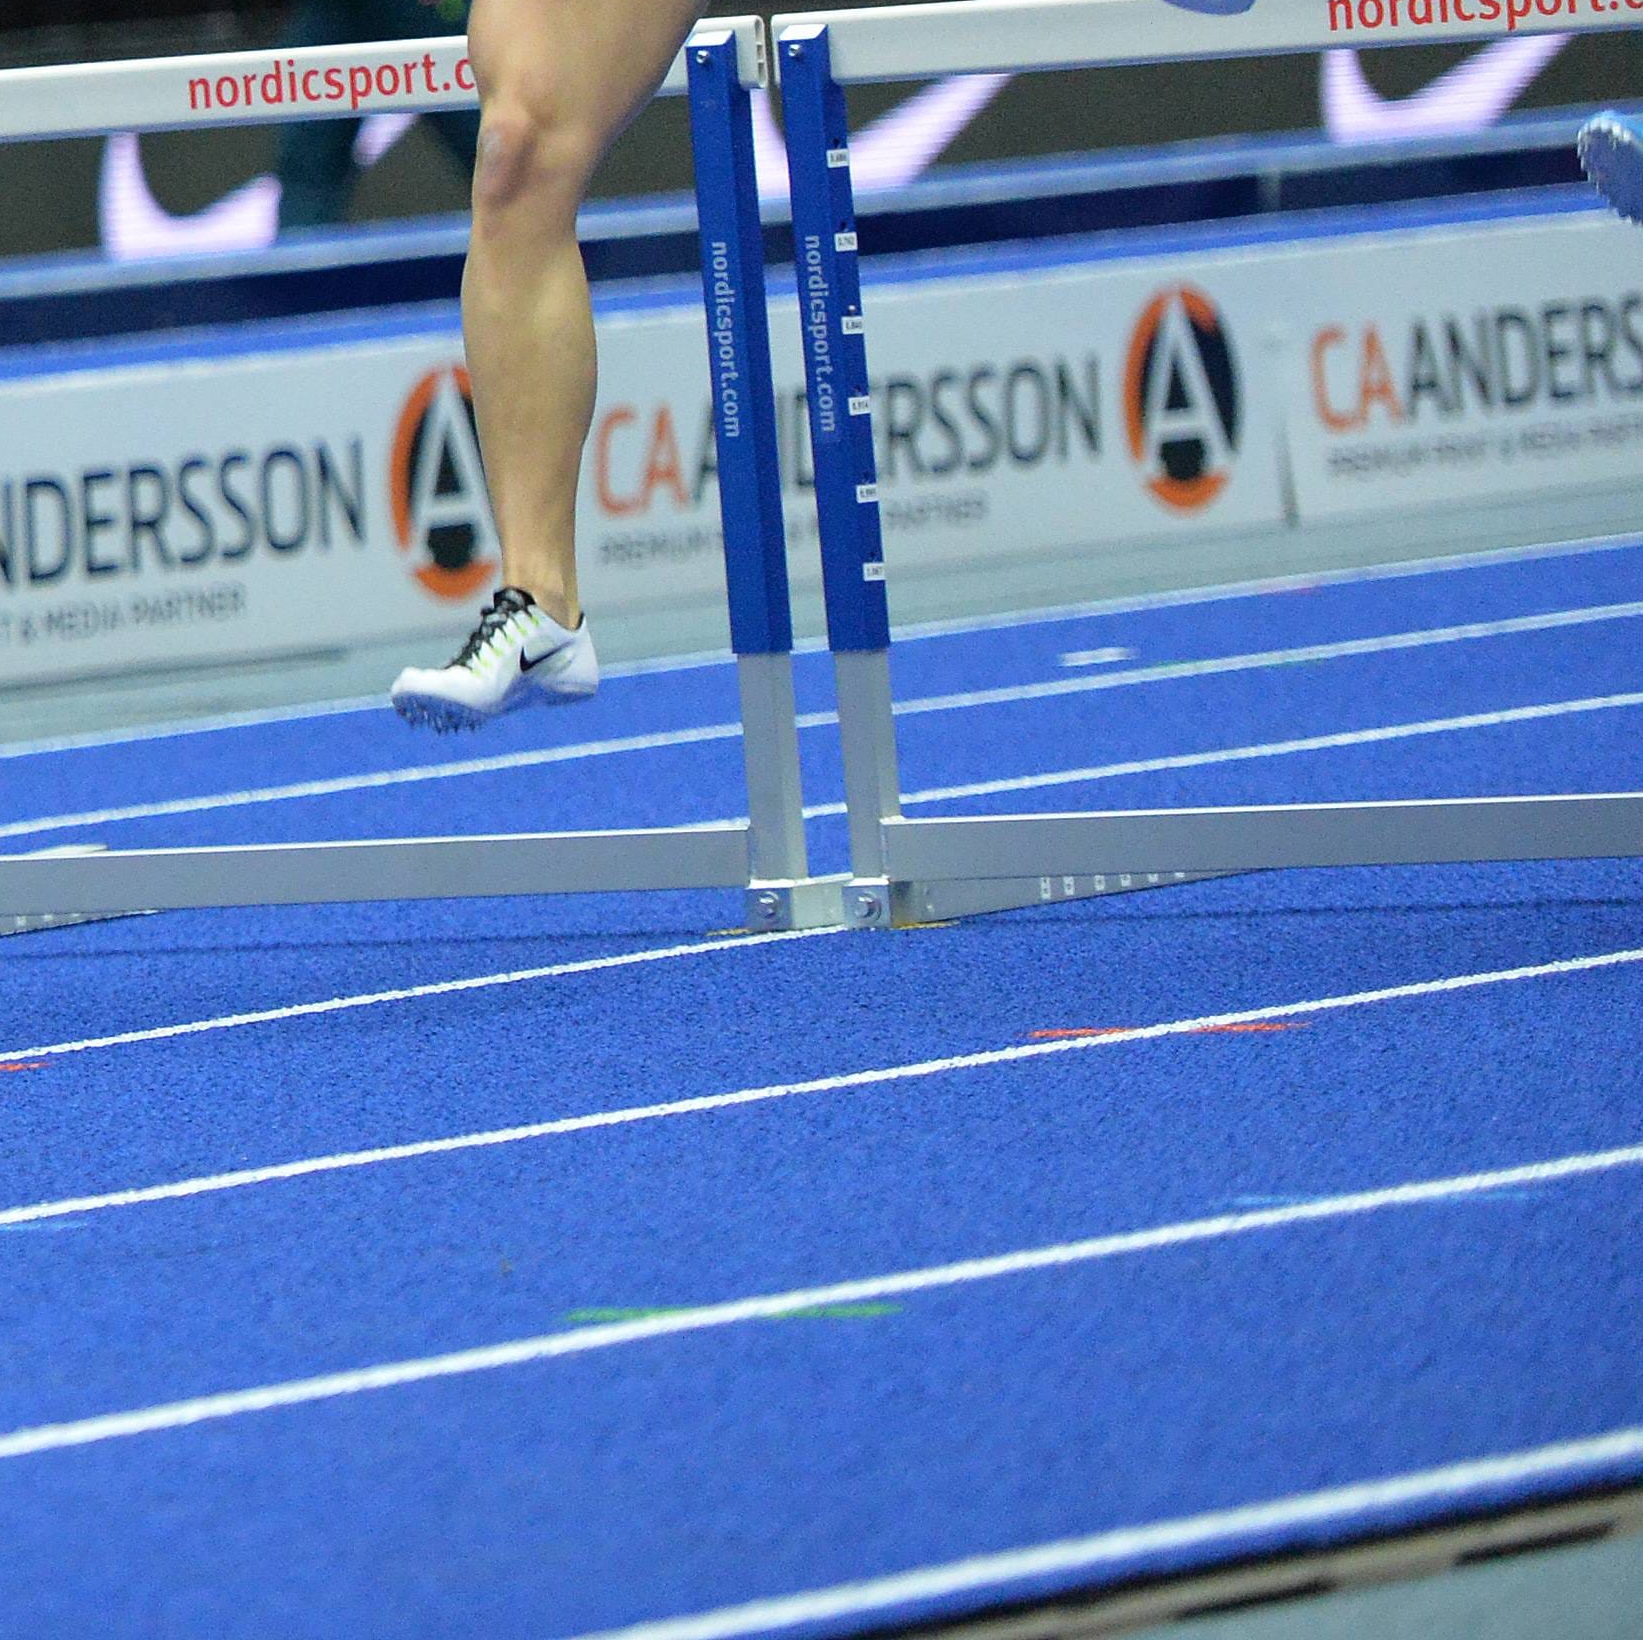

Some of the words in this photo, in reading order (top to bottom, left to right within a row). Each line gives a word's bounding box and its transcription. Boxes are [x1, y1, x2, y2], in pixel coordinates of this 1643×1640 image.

[712, 241, 741, 438] nordicsport.com
[806, 235, 836, 432] nordicsport.com
[46, 602, 123, 641] MEDIA
[134, 581, 247, 626] PARTNER
